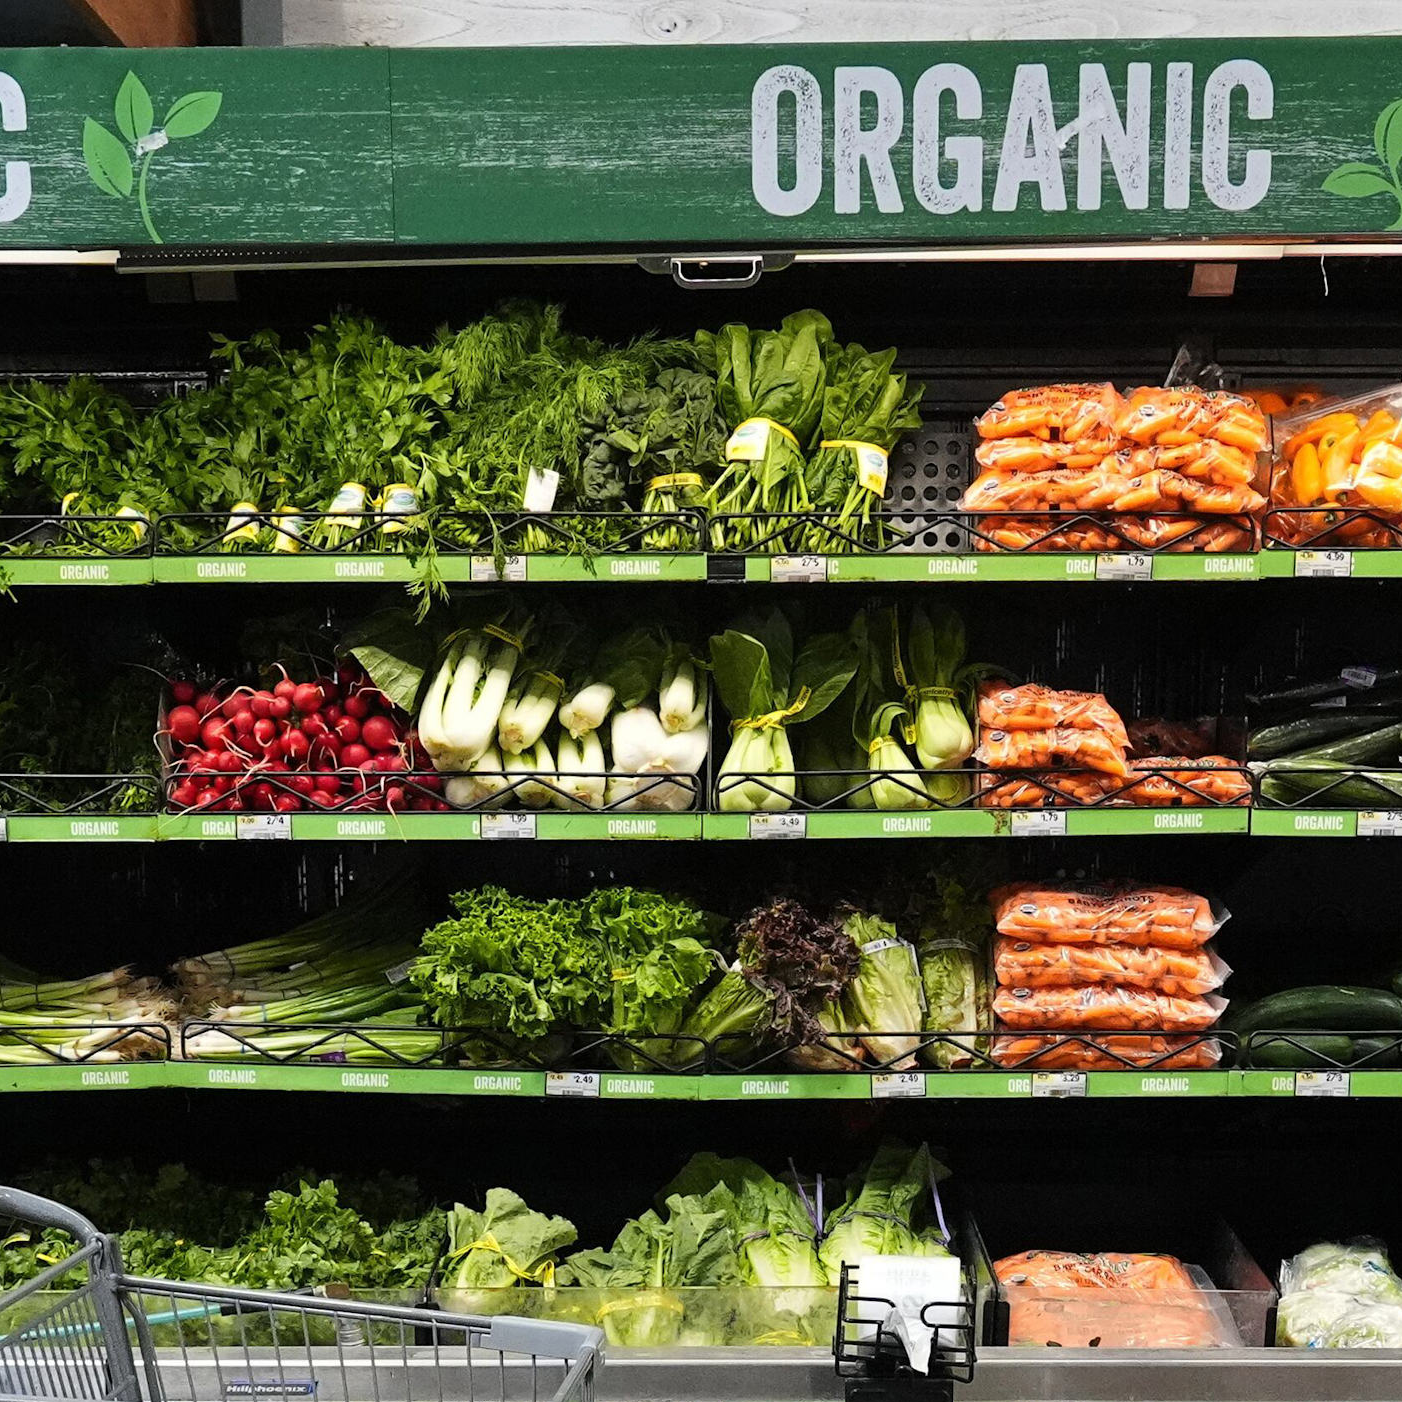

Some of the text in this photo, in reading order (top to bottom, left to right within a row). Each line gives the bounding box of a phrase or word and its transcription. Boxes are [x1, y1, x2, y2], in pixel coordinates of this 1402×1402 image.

[751, 58, 1274, 217] ORGANIC
[59, 565, 109, 580] ORGANIC
[197, 562, 247, 577] ORGANIC
[334, 561, 384, 577] ORGANIC
[610, 560, 661, 575] ORGANIC
[928, 560, 978, 575] ORGANIC
[1066, 559, 1095, 574] ORGA
[1204, 558, 1254, 573] ORGANIC
[337, 820, 386, 835] ORGANIC
[608, 819, 657, 834] ORGANIC
[883, 817, 932, 832] ORGANIC
[1154, 813, 1203, 828] ORGANIC
[1294, 816, 1343, 831] ORGANIC
[70, 821, 119, 836] ORGANIC
[82, 1071, 129, 1086] ORGANIC
[208, 1069, 256, 1084] ORGANIC
[341, 1073, 389, 1088] ORGANIC
[474, 1076, 522, 1091] ORGANIC
[607, 1079, 654, 1094] ORGANIC
[741, 1080, 789, 1095] ORGANIC
[1141, 1077, 1189, 1092] ORGANIC
